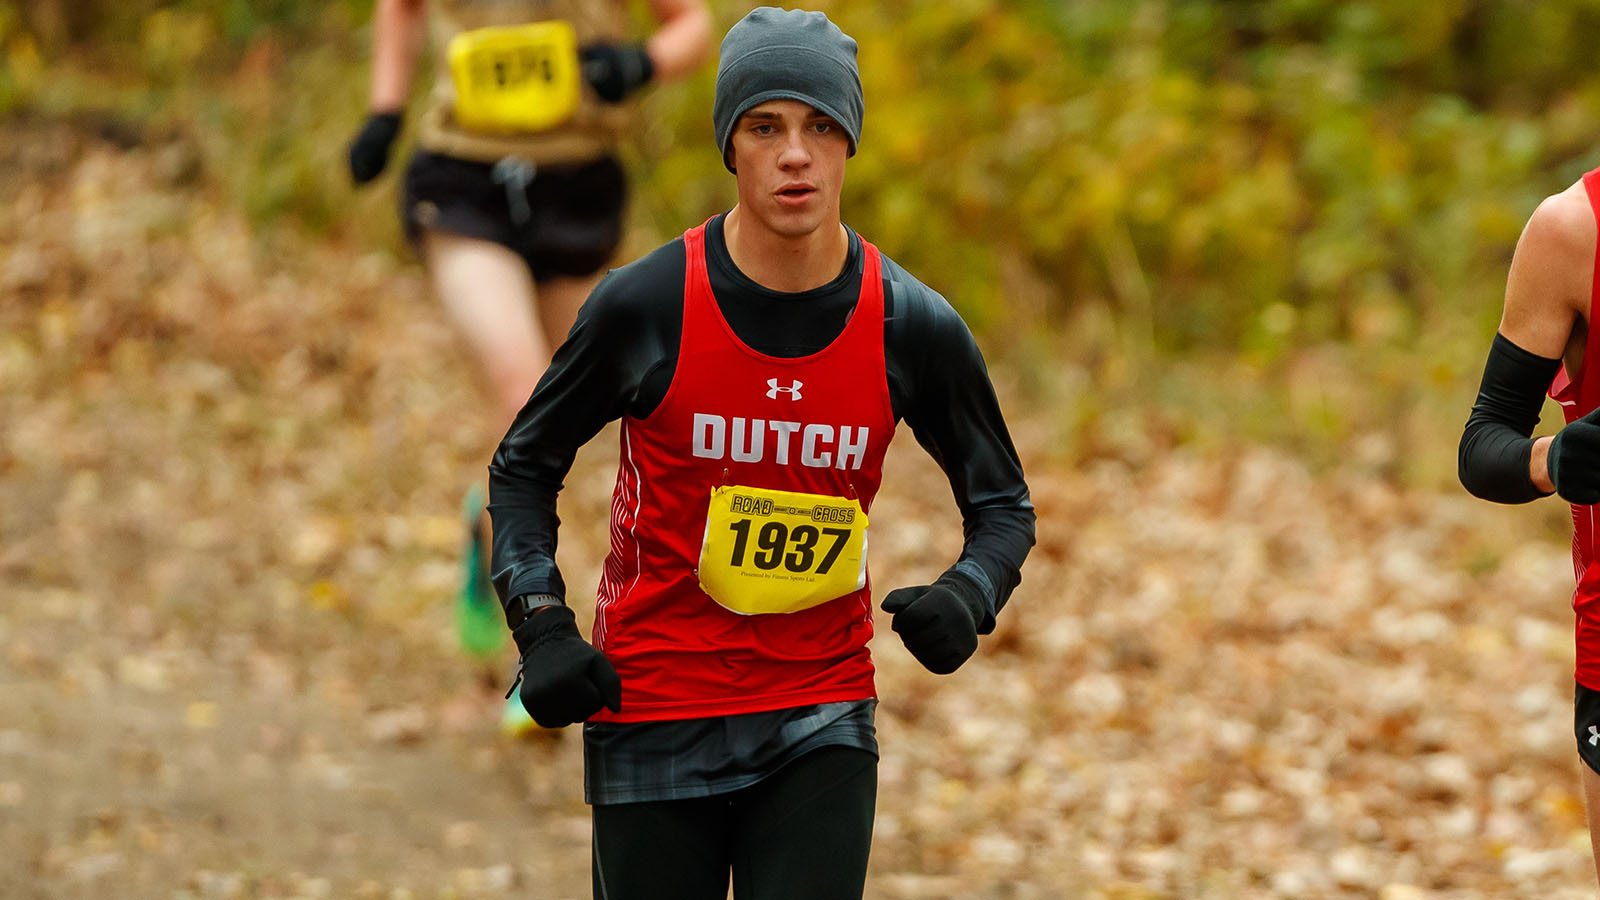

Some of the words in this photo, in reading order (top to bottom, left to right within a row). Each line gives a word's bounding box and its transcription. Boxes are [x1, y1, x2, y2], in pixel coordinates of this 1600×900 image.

[693, 413, 869, 470] DUTCH
[731, 494, 774, 517] ROAD
[811, 505, 856, 524] CROSS
[730, 519, 852, 575] 1937
